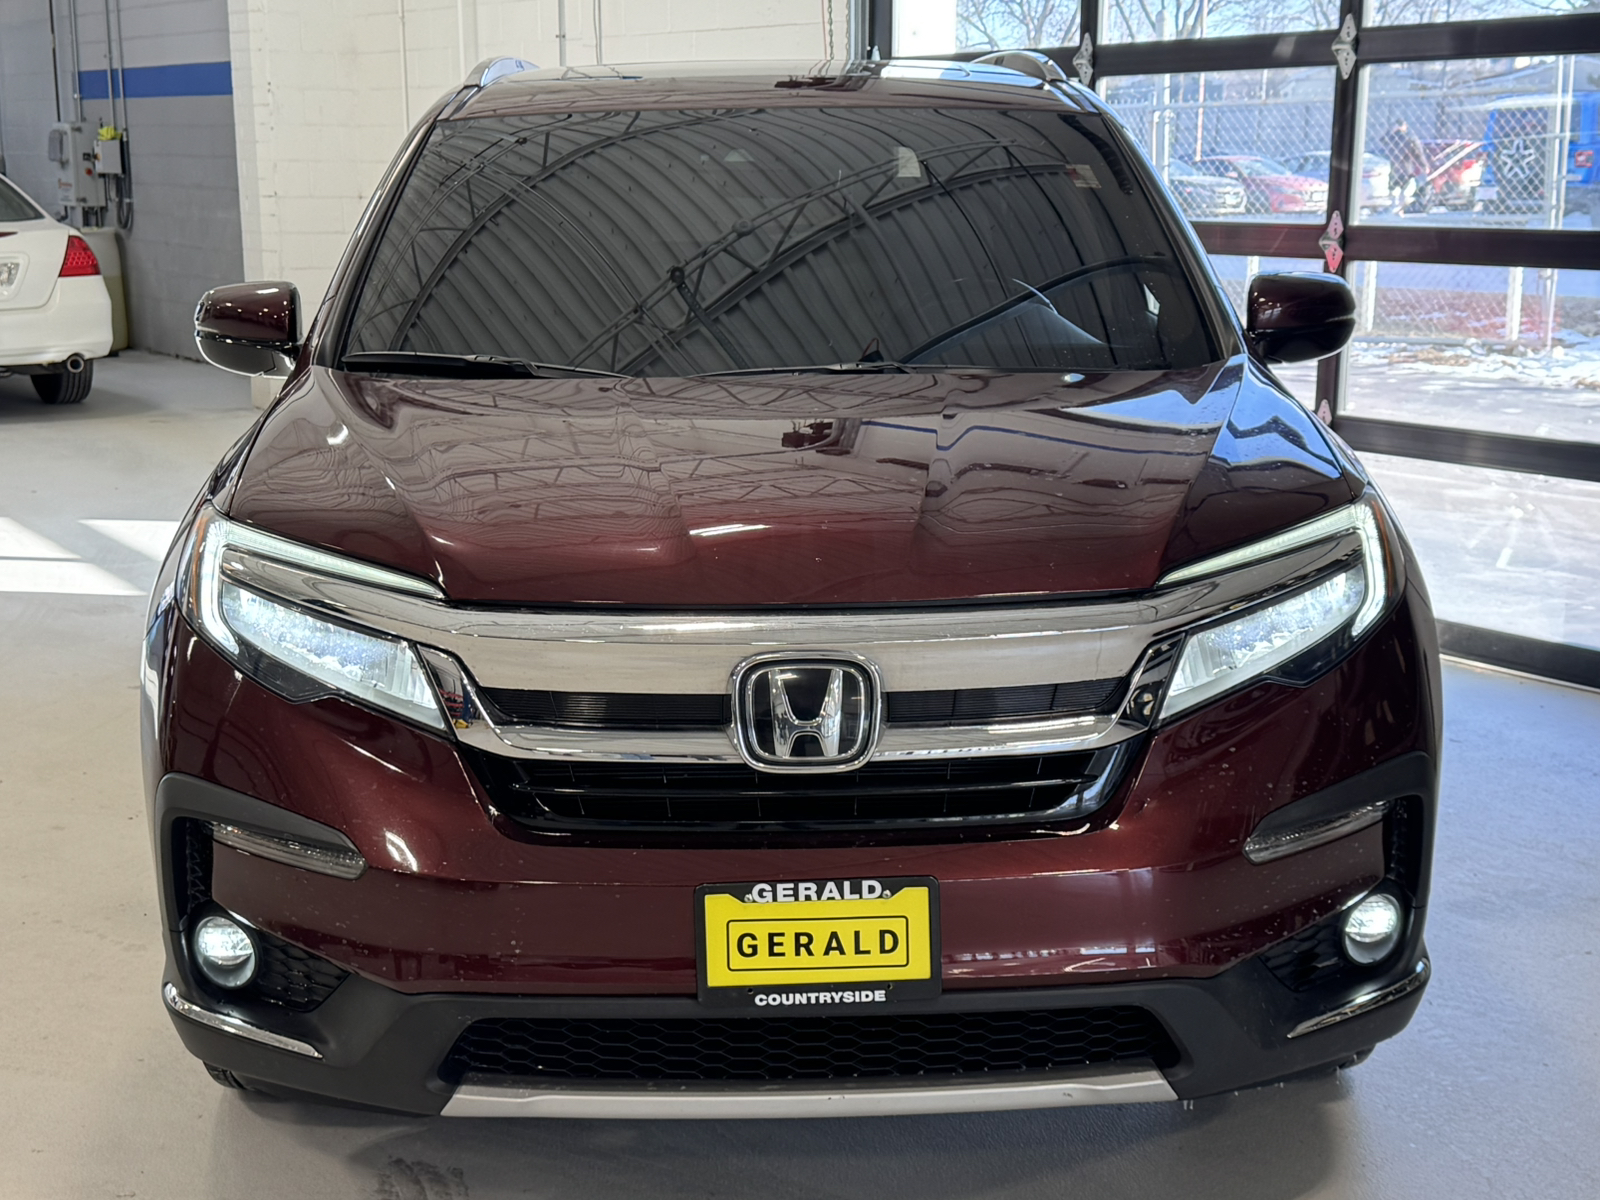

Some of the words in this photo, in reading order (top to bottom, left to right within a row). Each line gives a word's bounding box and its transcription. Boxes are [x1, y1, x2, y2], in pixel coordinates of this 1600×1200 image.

[752, 880, 882, 903] GERALD
[736, 929, 899, 958] GERALD
[754, 990, 886, 1006] COUNTRYSIDE
